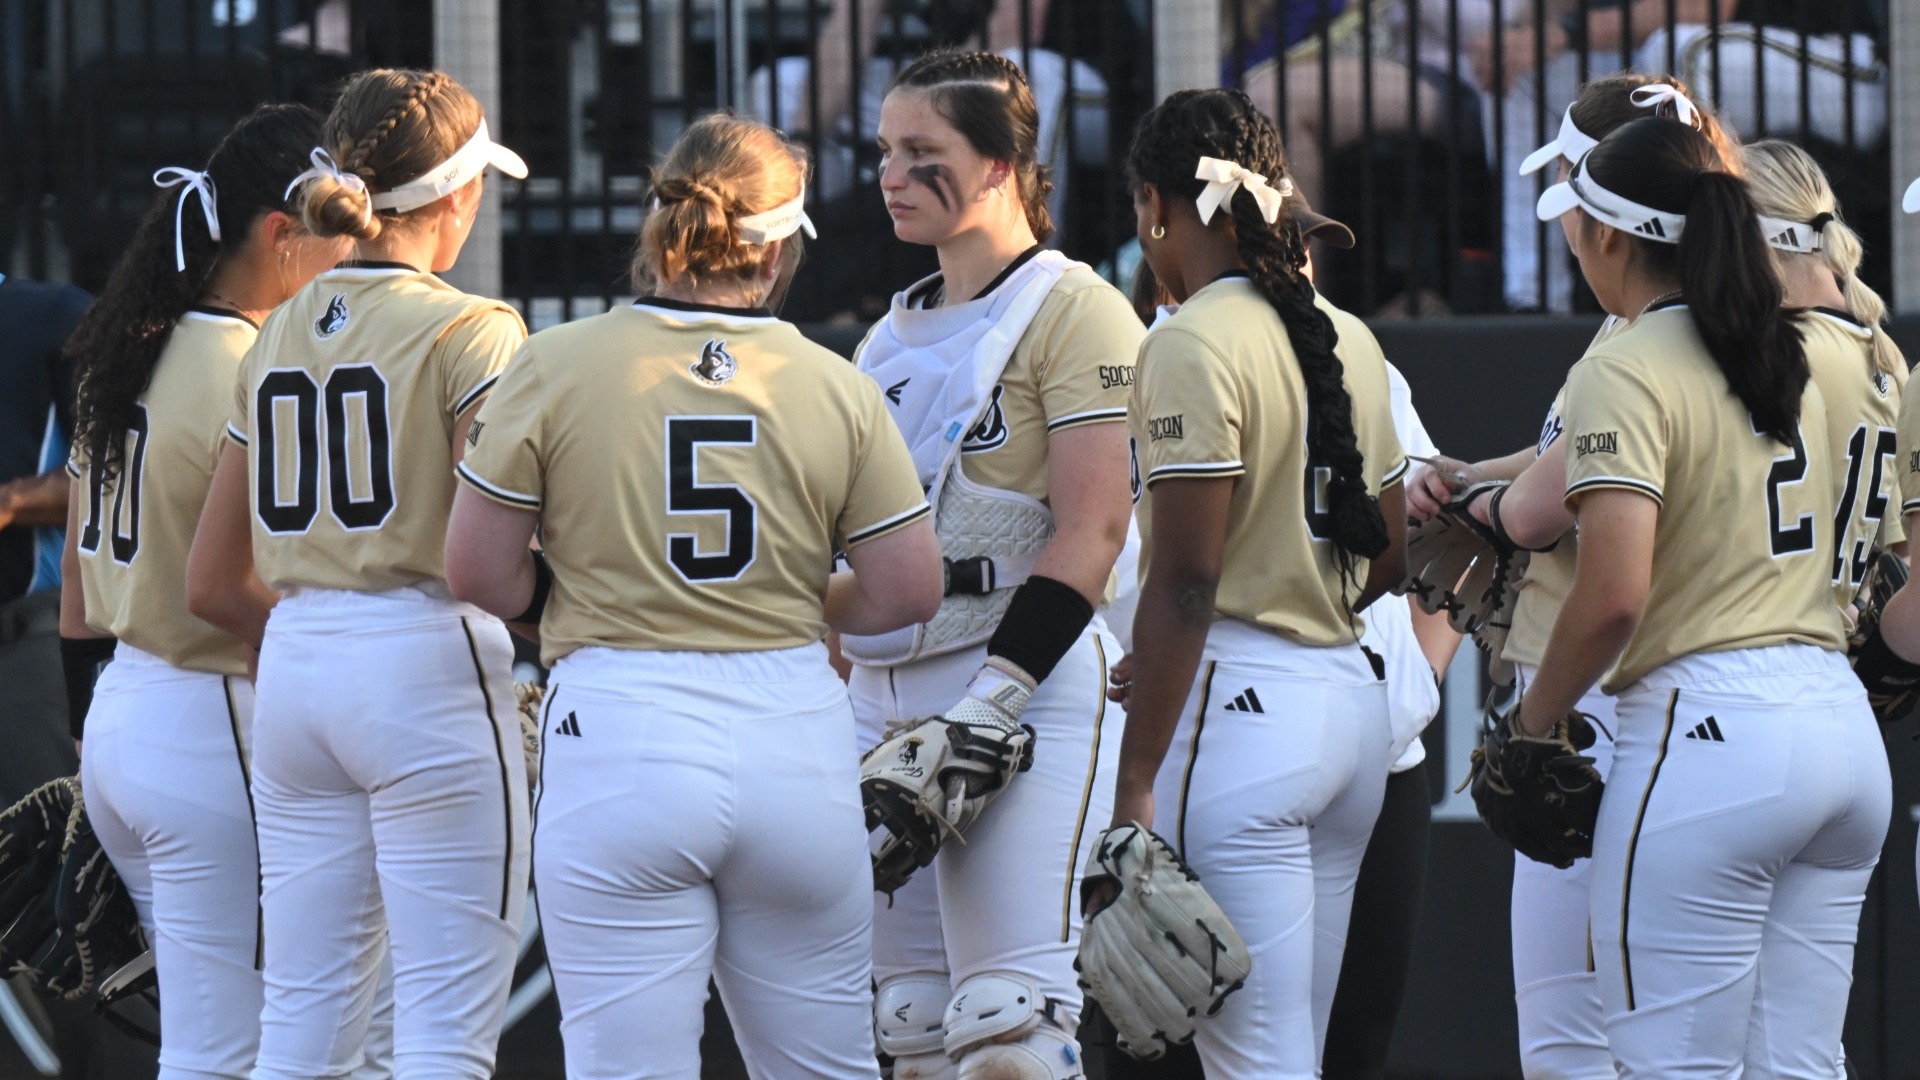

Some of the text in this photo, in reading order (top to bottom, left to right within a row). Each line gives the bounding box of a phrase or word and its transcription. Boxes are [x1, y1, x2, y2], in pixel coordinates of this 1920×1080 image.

[256, 361, 397, 537] 00
[1099, 365, 1136, 390] SOCO
[78, 401, 149, 568] 10
[665, 415, 757, 584] 5
[1750, 408, 1815, 560] 2
[1831, 422, 1897, 587] 15
